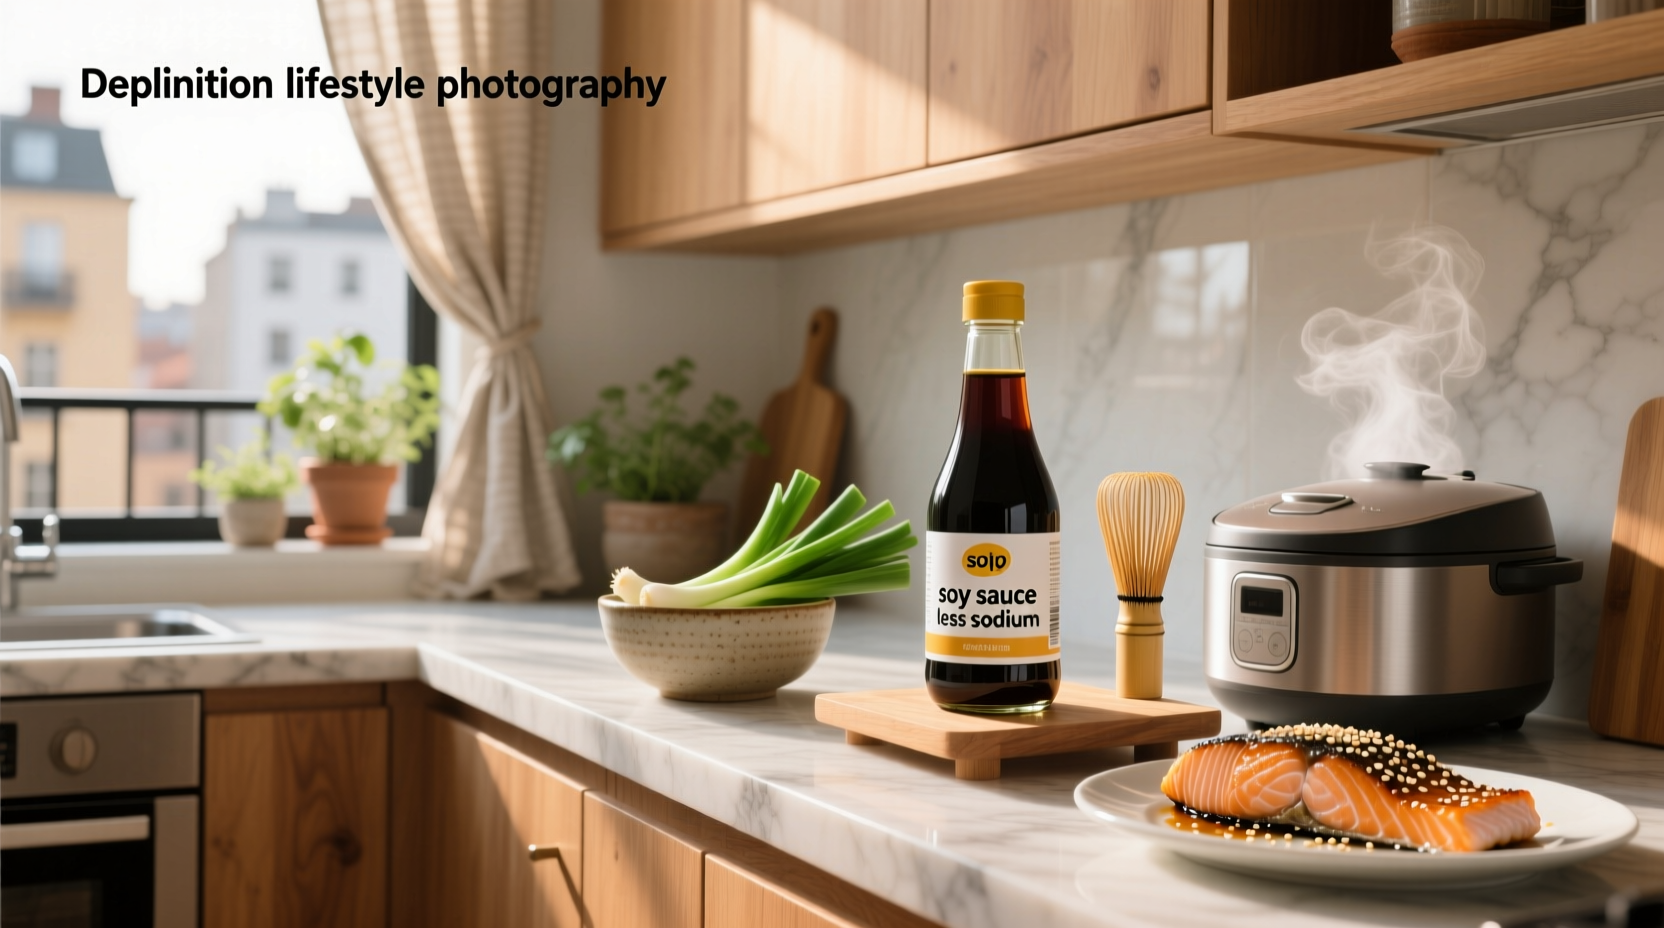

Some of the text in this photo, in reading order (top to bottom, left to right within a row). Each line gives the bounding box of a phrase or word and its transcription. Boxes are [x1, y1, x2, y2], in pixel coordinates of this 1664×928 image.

[938, 587, 1037, 610] soy sauce
[937, 607, 1040, 629] less sodium
